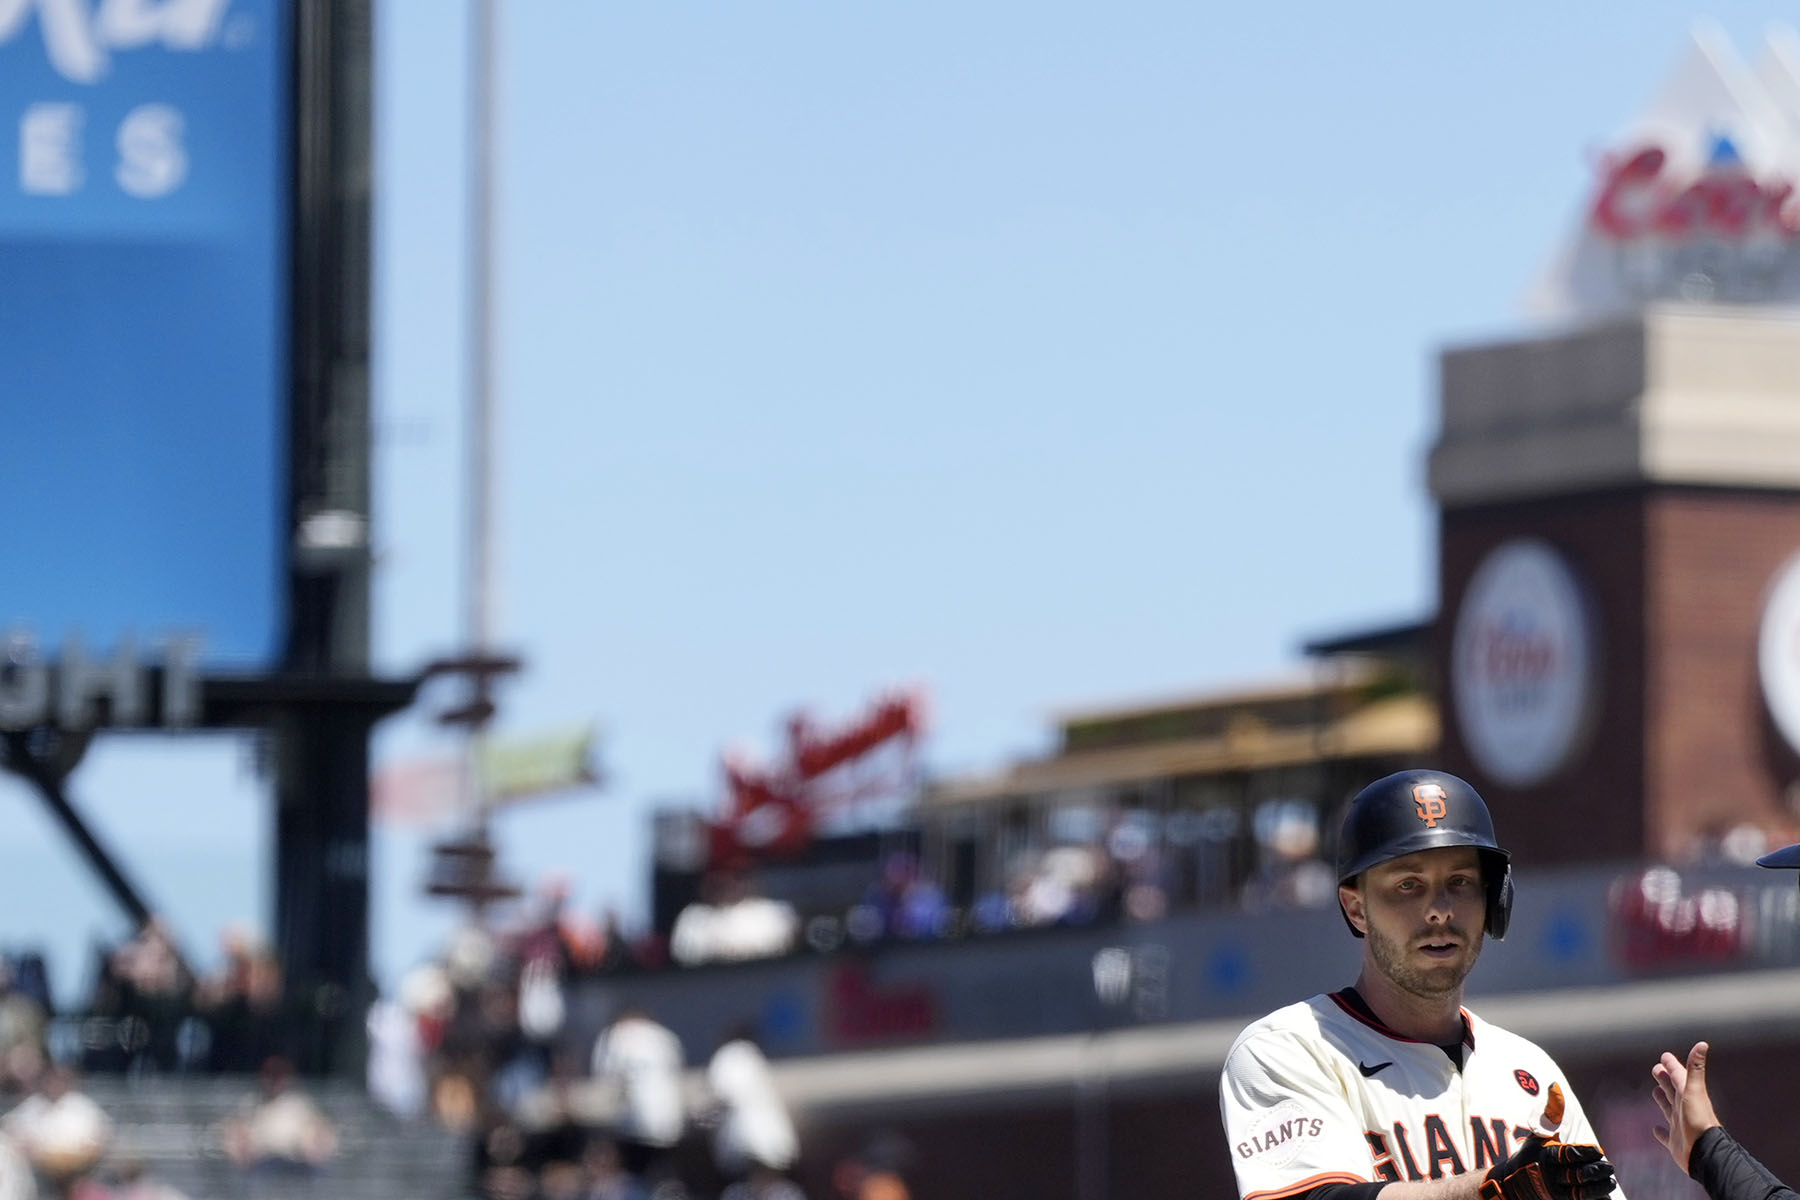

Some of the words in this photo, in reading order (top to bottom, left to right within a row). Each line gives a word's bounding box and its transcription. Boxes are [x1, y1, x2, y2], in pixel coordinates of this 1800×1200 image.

[1519, 1076, 1538, 1091] 24
[1237, 1117, 1324, 1159] GIANTS
[1364, 1113, 1532, 1182] GIAN
